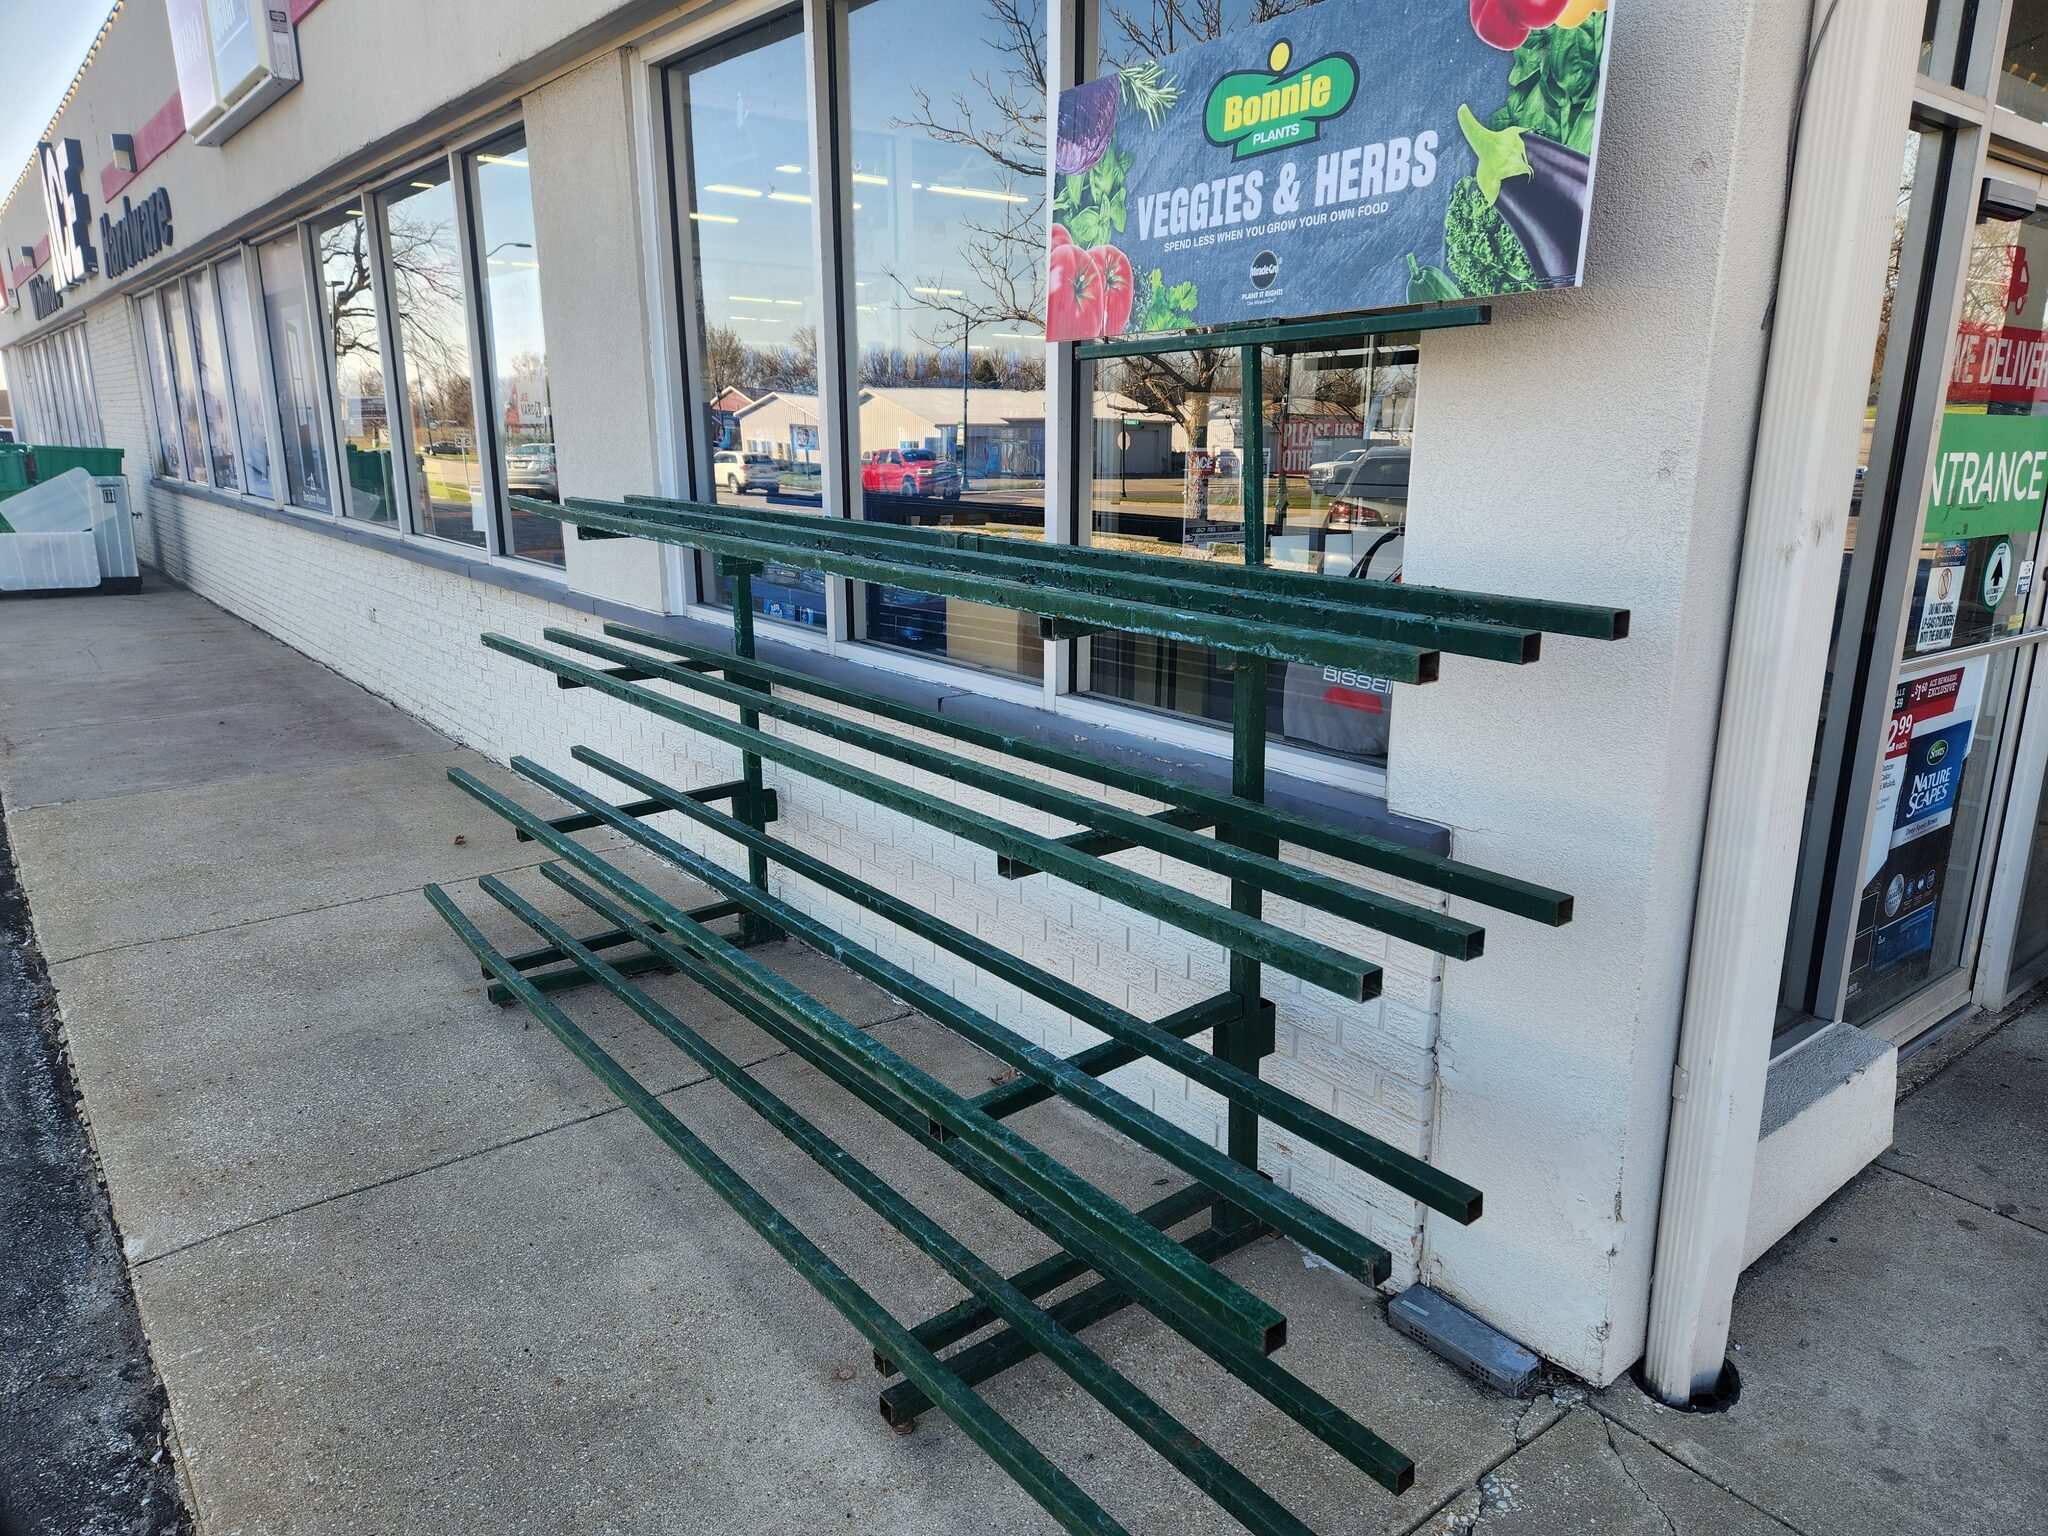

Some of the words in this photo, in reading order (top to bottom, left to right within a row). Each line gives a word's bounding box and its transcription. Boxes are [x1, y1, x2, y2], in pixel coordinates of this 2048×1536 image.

[1224, 74, 1331, 132] Bonnie
[1252, 123, 1300, 146] PLANTS
[1137, 170, 1264, 241] VEGGIES
[1272, 162, 1301, 215] &
[1314, 130, 1439, 207] HERBS
[37, 138, 97, 294] ACE
[1164, 239, 1192, 253] SPEND
[1193, 234, 1215, 247] LESS
[1216, 230, 1243, 243] WHEN
[1245, 225, 1265, 238] YOU
[1267, 219, 1297, 234] GROW
[1299, 213, 1327, 228] YOUR
[1330, 208, 1355, 222] OWN
[1358, 201, 1389, 217] FOOD
[100, 186, 174, 279] Hardware
[1241, 292, 1258, 300] PLANT
[1282, 450, 1312, 472] OTHE
[1932, 451, 2047, 507] NTRANCE
[1928, 603, 1936, 616] DO
[1942, 601, 1954, 614] BRING
[1929, 679, 1938, 688] ACE
[1895, 740, 1908, 750] each
[1911, 767, 1952, 795] NATURE
[1906, 783, 1949, 818] SCAPES
